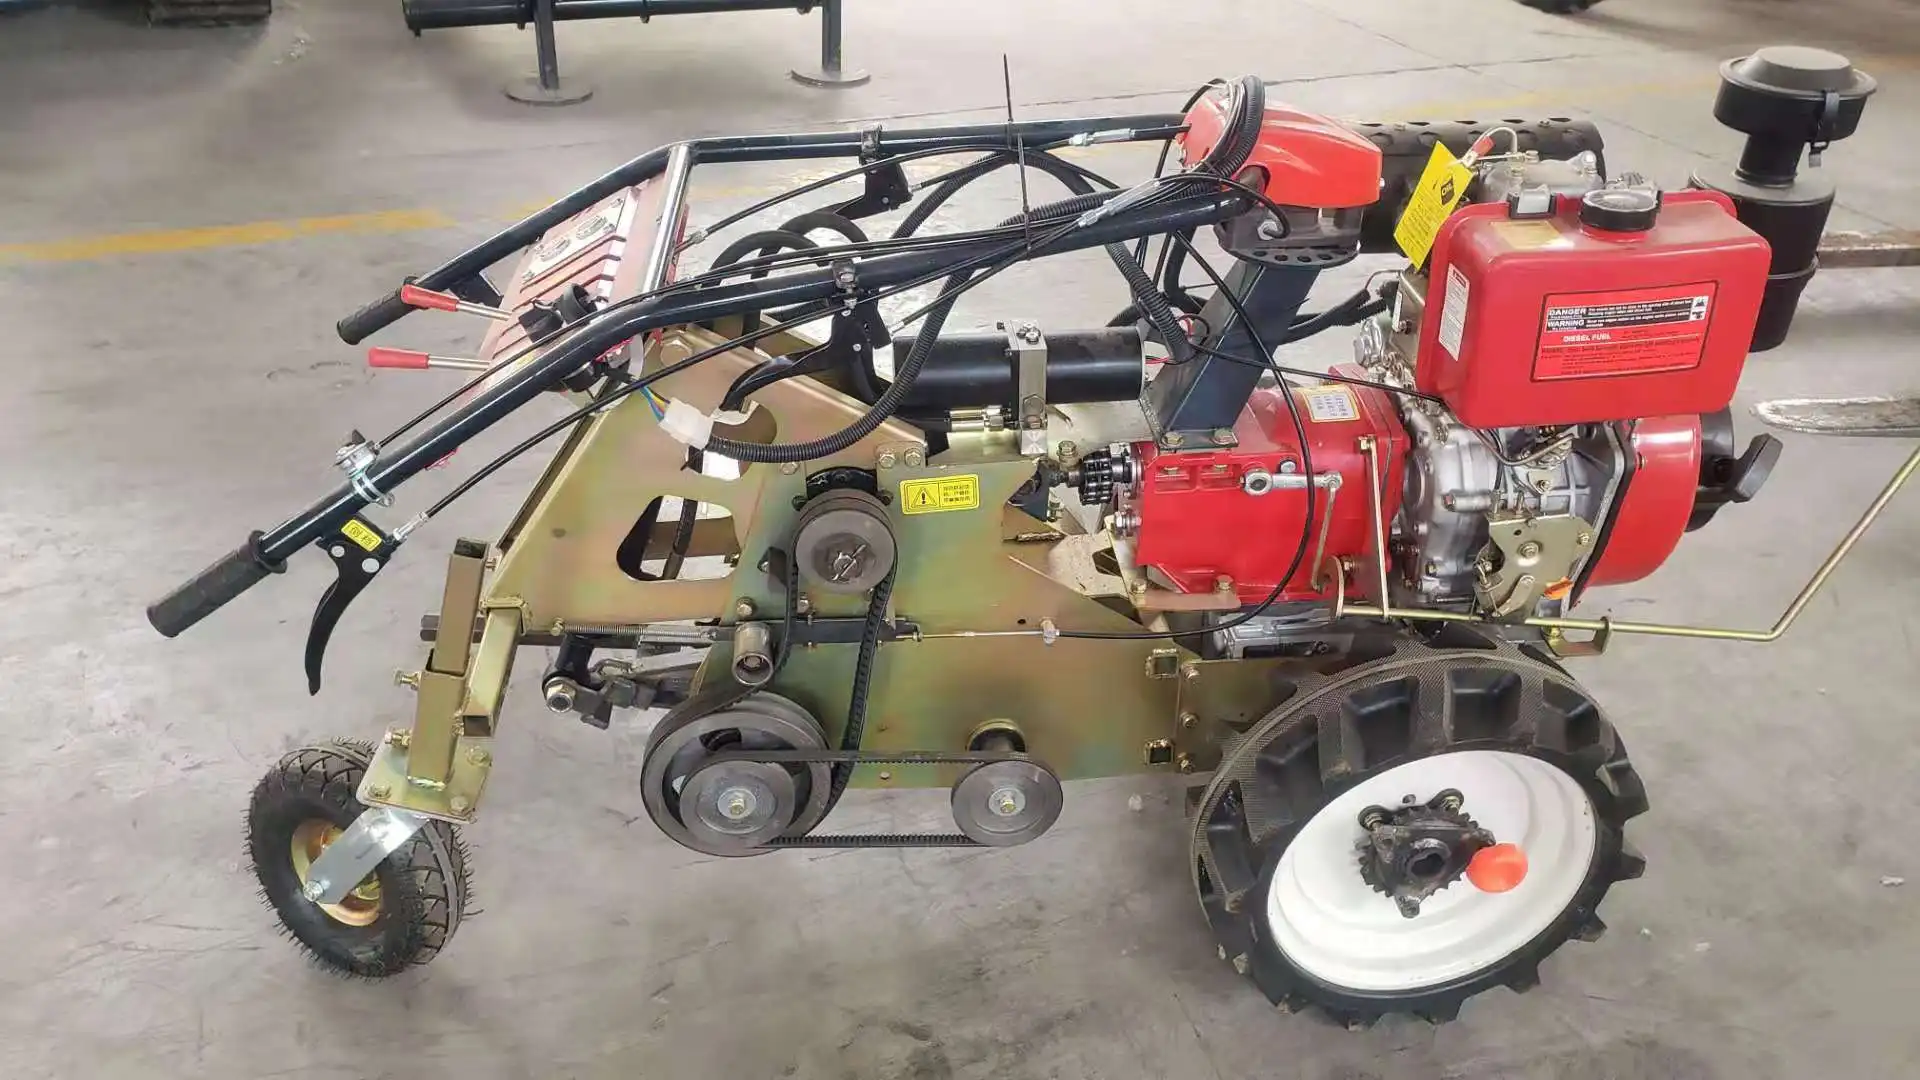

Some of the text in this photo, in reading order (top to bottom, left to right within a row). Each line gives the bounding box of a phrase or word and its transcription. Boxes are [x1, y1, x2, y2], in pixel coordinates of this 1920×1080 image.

[1549, 307, 1587, 316] DANGER
[1548, 319, 1585, 328] WARNING
[1563, 334, 1591, 342] DIESEL
